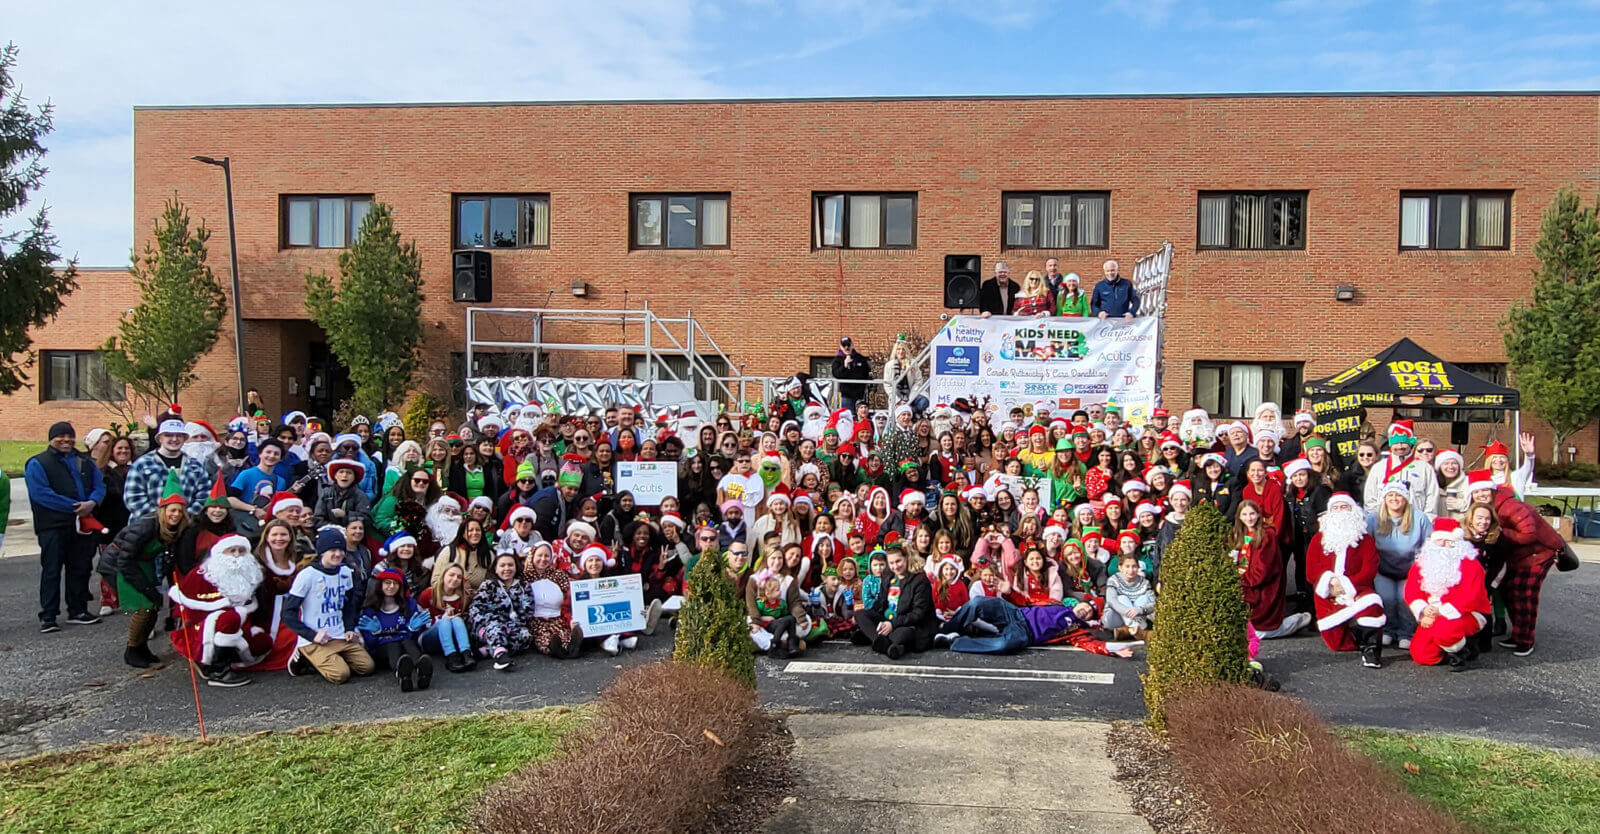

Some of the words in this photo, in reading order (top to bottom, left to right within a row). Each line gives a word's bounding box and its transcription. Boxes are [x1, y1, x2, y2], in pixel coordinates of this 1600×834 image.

[955, 327, 985, 338] healthy
[1047, 329, 1080, 339] NEED
[955, 335, 982, 343] futures
[945, 356, 971, 364] Allstate
[1097, 350, 1132, 362] Acutis
[1386, 360, 1446, 374] 106.1
[1390, 373, 1455, 389] BLI
[1376, 393, 1395, 402] BLI
[1484, 395, 1504, 404] BLI
[1312, 399, 1338, 413] 106.1
[1336, 394, 1362, 409] BLI
[1336, 416, 1360, 431] BLI
[1337, 440, 1359, 454] BLI
[632, 483, 663, 493] Acutis
